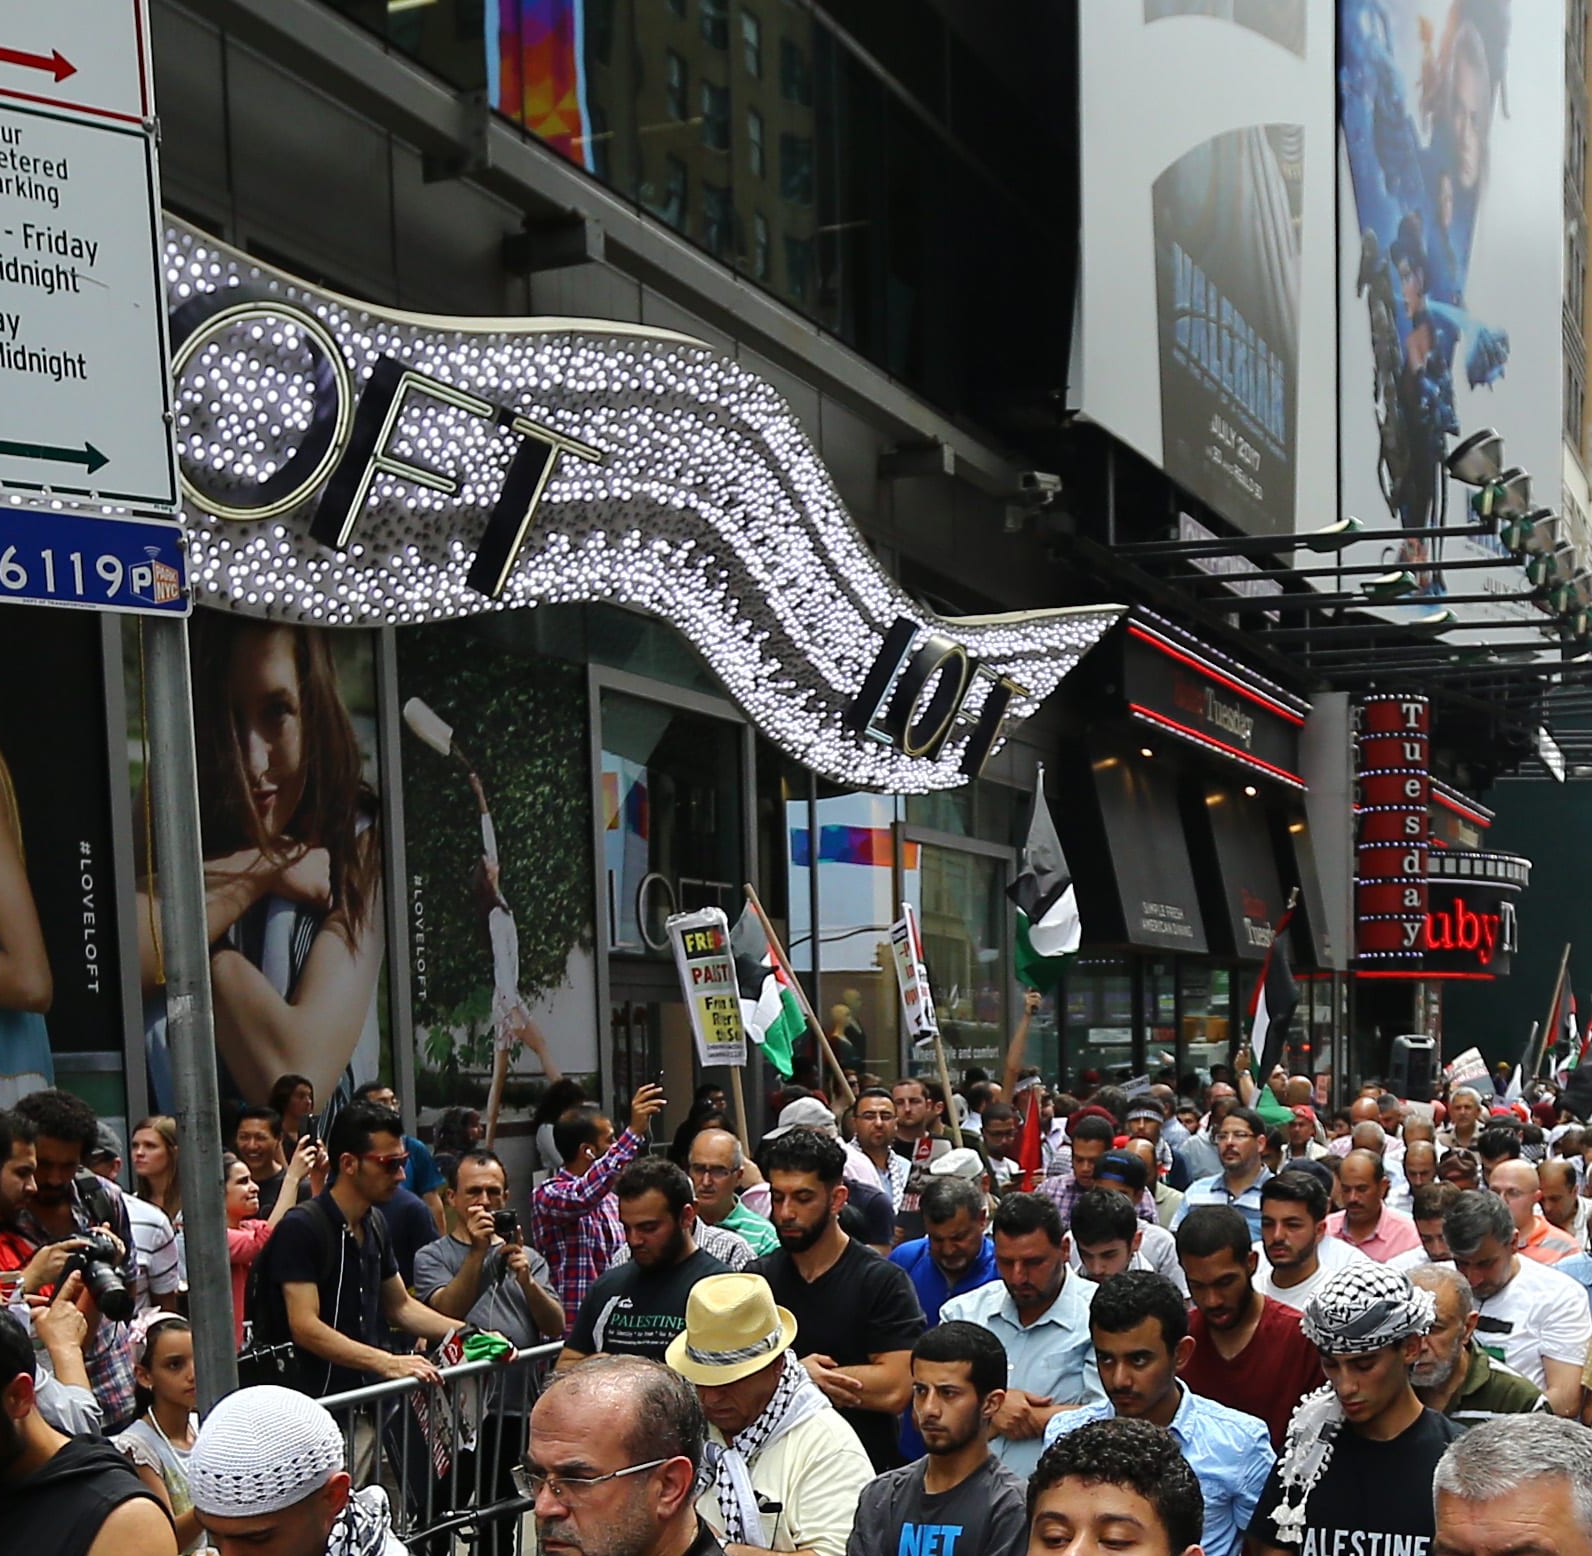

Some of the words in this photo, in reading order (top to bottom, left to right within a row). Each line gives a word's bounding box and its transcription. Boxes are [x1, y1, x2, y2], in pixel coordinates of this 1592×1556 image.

[22, 223, 98, 267] Friday
[157, 580, 180, 600] NYC
[850, 616, 1030, 778] LOFT
[1206, 686, 1254, 749] Tuesday
[1402, 703, 1423, 946] Tuesday
[79, 840, 100, 994] #LOVELOFT
[610, 1312, 686, 1331] PALESTINE
